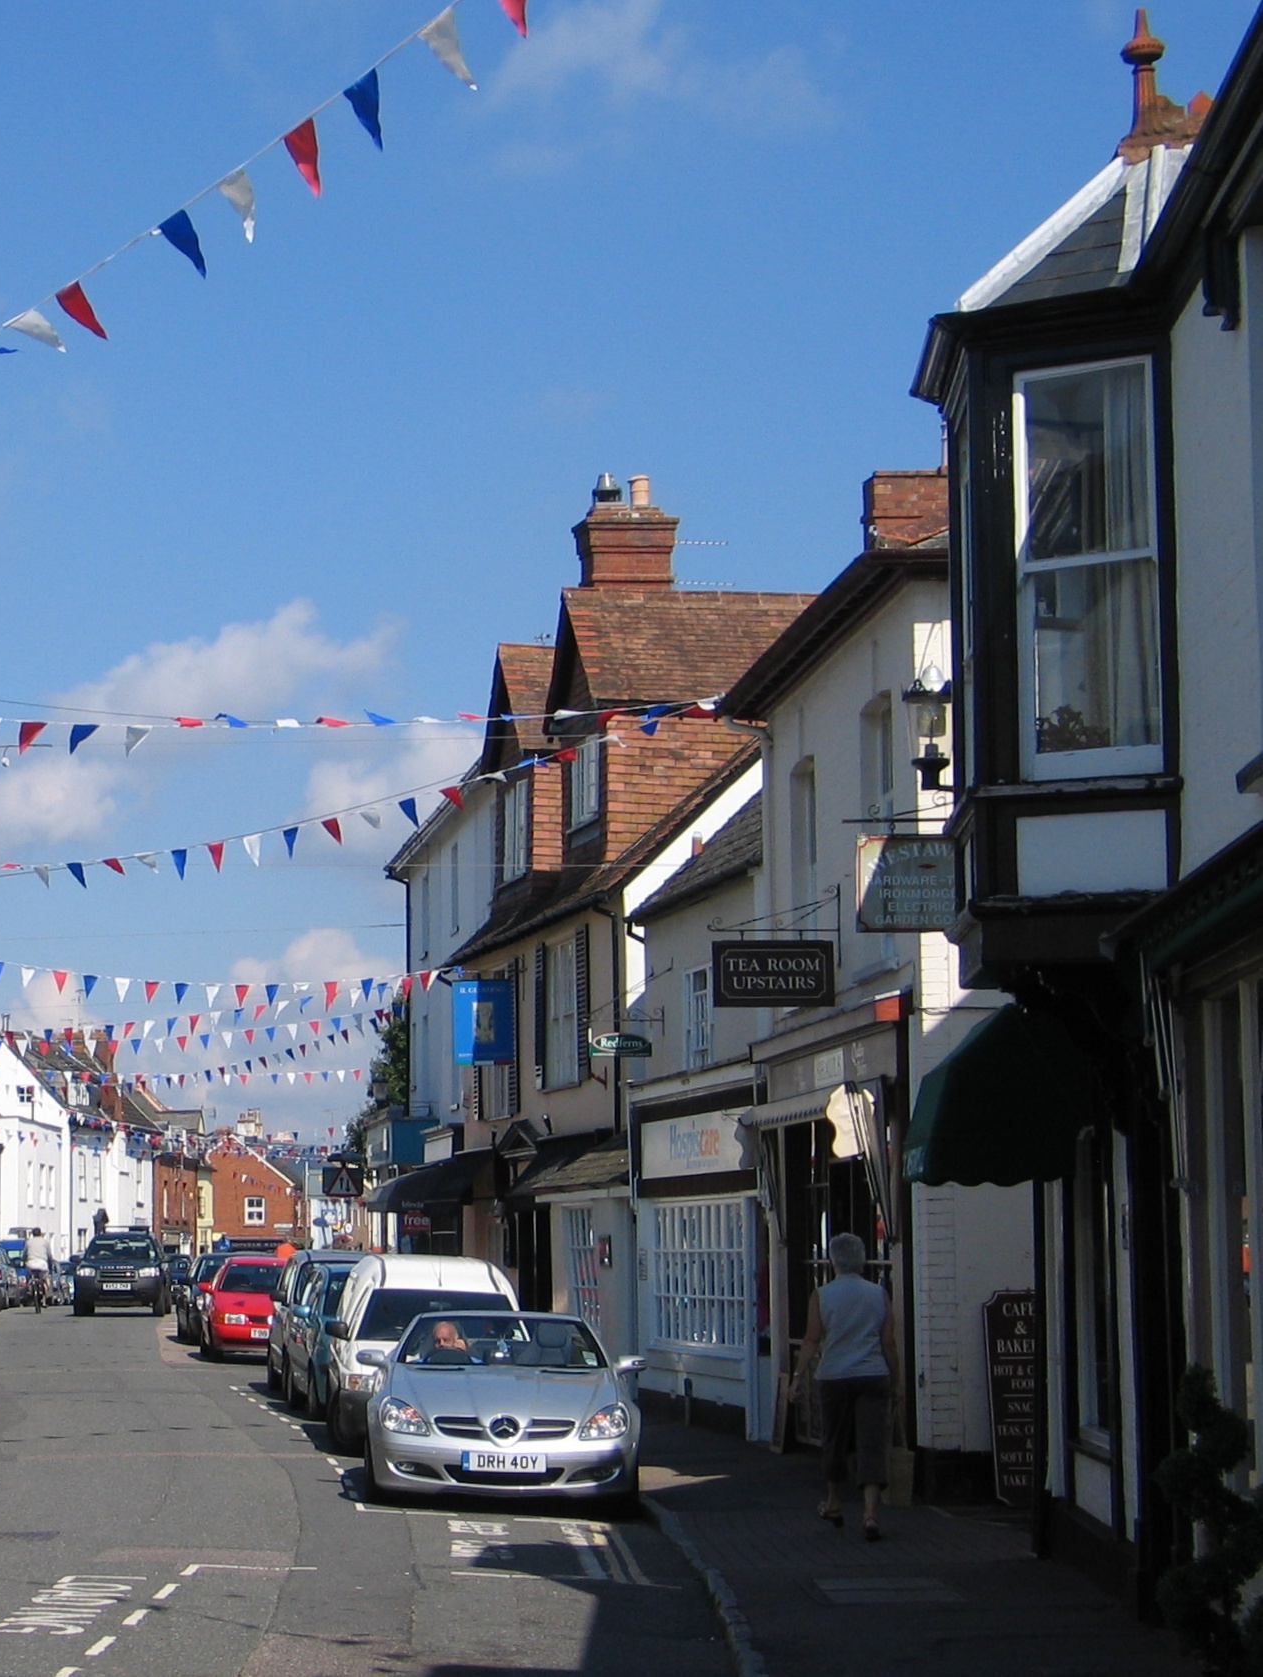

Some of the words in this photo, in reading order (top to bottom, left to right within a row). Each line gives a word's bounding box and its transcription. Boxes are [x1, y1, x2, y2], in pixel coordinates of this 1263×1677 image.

[875, 914, 929, 925] GARDEN
[725, 958, 760, 972] TEA
[767, 958, 820, 972] ROOM
[733, 976, 816, 989] UPSTAIRS
[600, 1036, 643, 1048] Redferns
[404, 1214, 429, 1226] free
[1014, 1320, 1027, 1335] &
[994, 1365, 1013, 1376] HOT
[477, 1454, 506, 1469] DRH
[1002, 1475, 1027, 1486] TAKE
